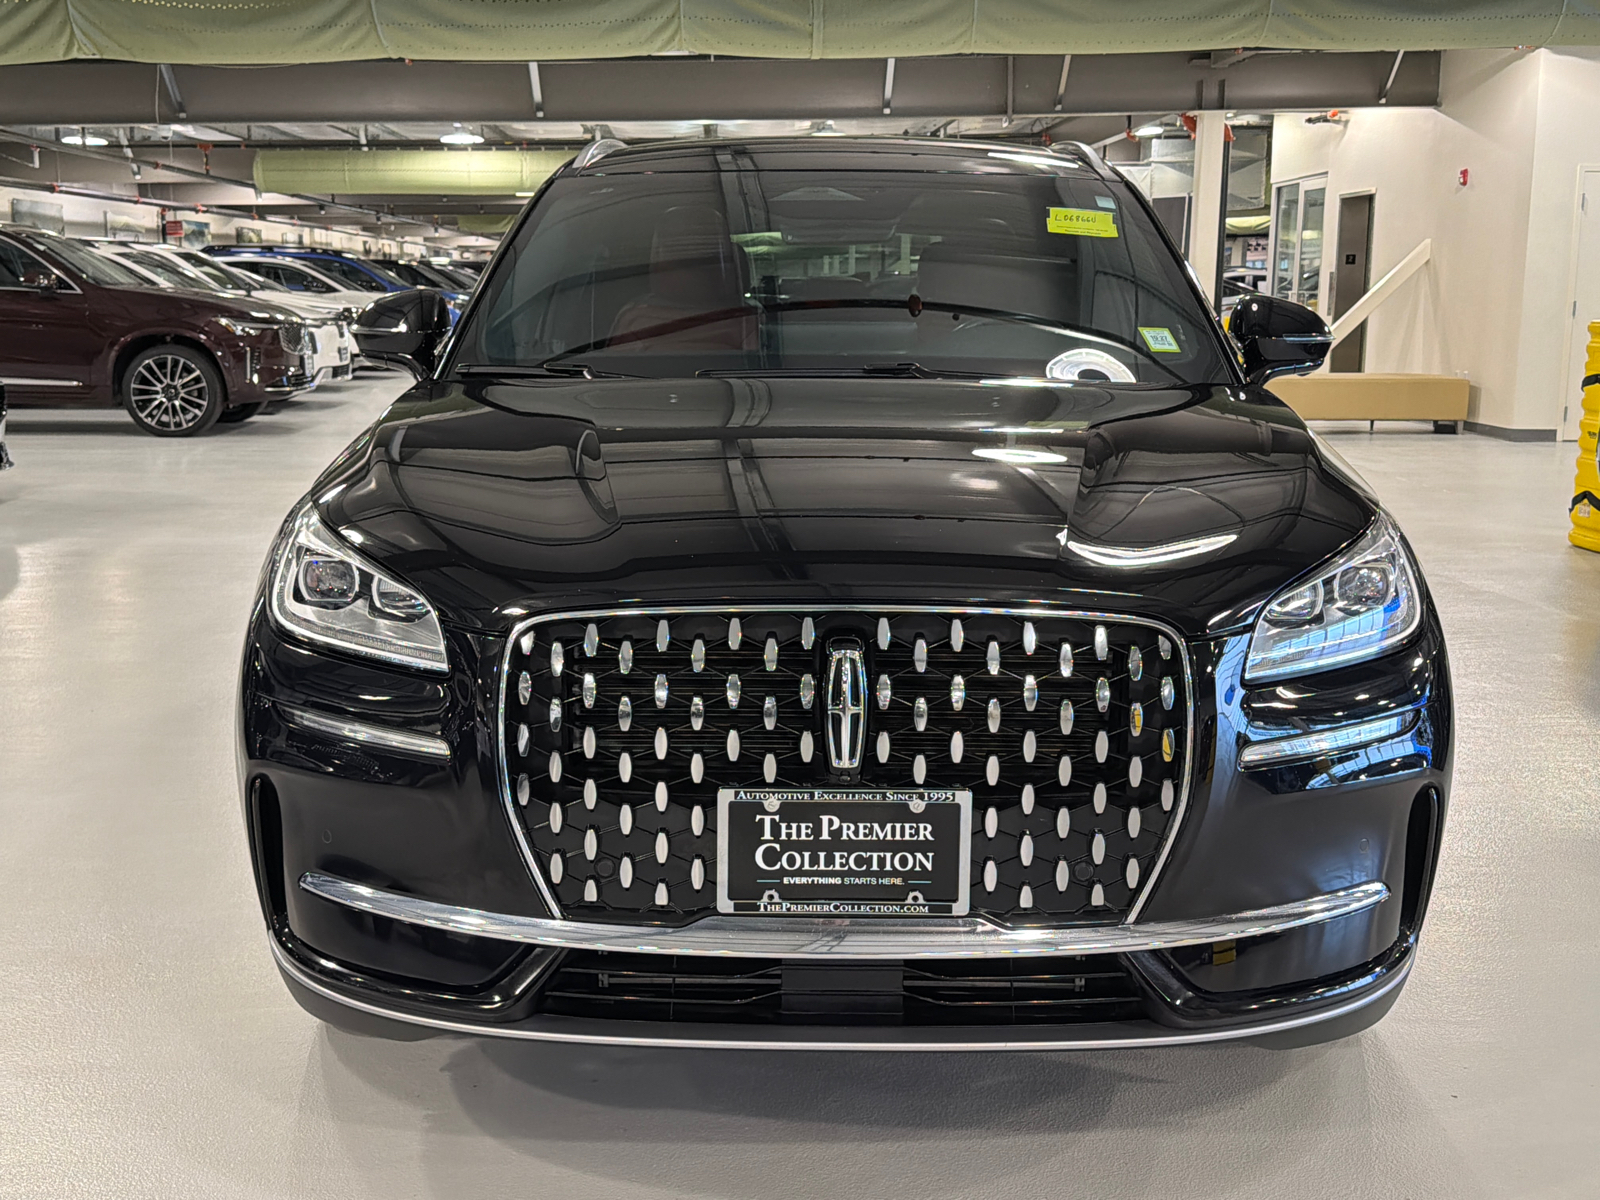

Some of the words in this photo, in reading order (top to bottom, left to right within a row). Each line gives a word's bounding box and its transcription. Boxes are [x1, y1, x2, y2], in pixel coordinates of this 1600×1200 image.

[736, 790, 811, 800] AUTOMOTIVE
[813, 790, 883, 801] EXCELLENCE
[885, 791, 920, 801] SINCE
[923, 792, 954, 802] 1995
[755, 814, 814, 840] THE
[819, 814, 935, 841] PREMIER
[754, 843, 934, 871] COLLECTION
[783, 877, 842, 885] EVERYTHING
[844, 877, 877, 885] STARTS
[878, 877, 905, 886] HERE.
